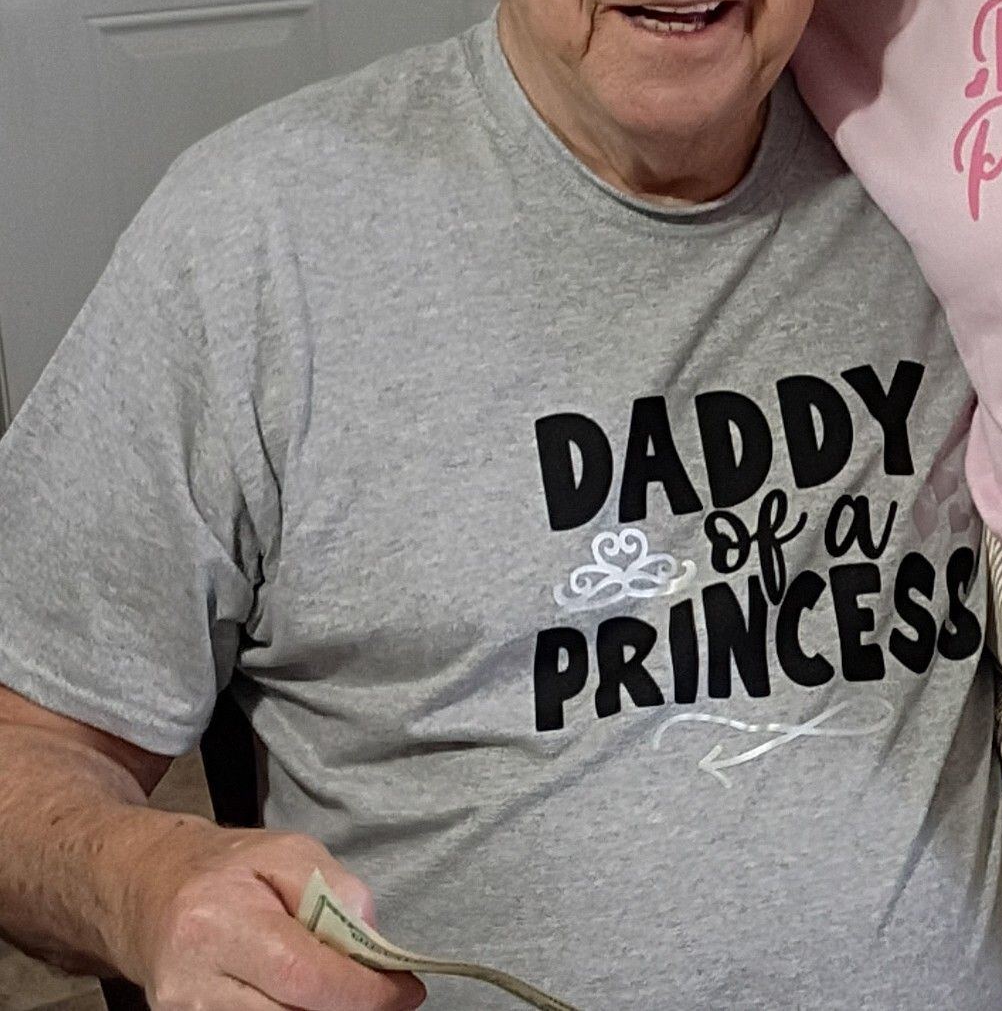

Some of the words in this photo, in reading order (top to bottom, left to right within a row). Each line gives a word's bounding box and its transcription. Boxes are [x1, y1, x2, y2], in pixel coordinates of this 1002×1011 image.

[535, 360, 925, 531] DADDY
[704, 489, 807, 605] of
[824, 494, 898, 559] a
[534, 546, 983, 732] PRINCESS
